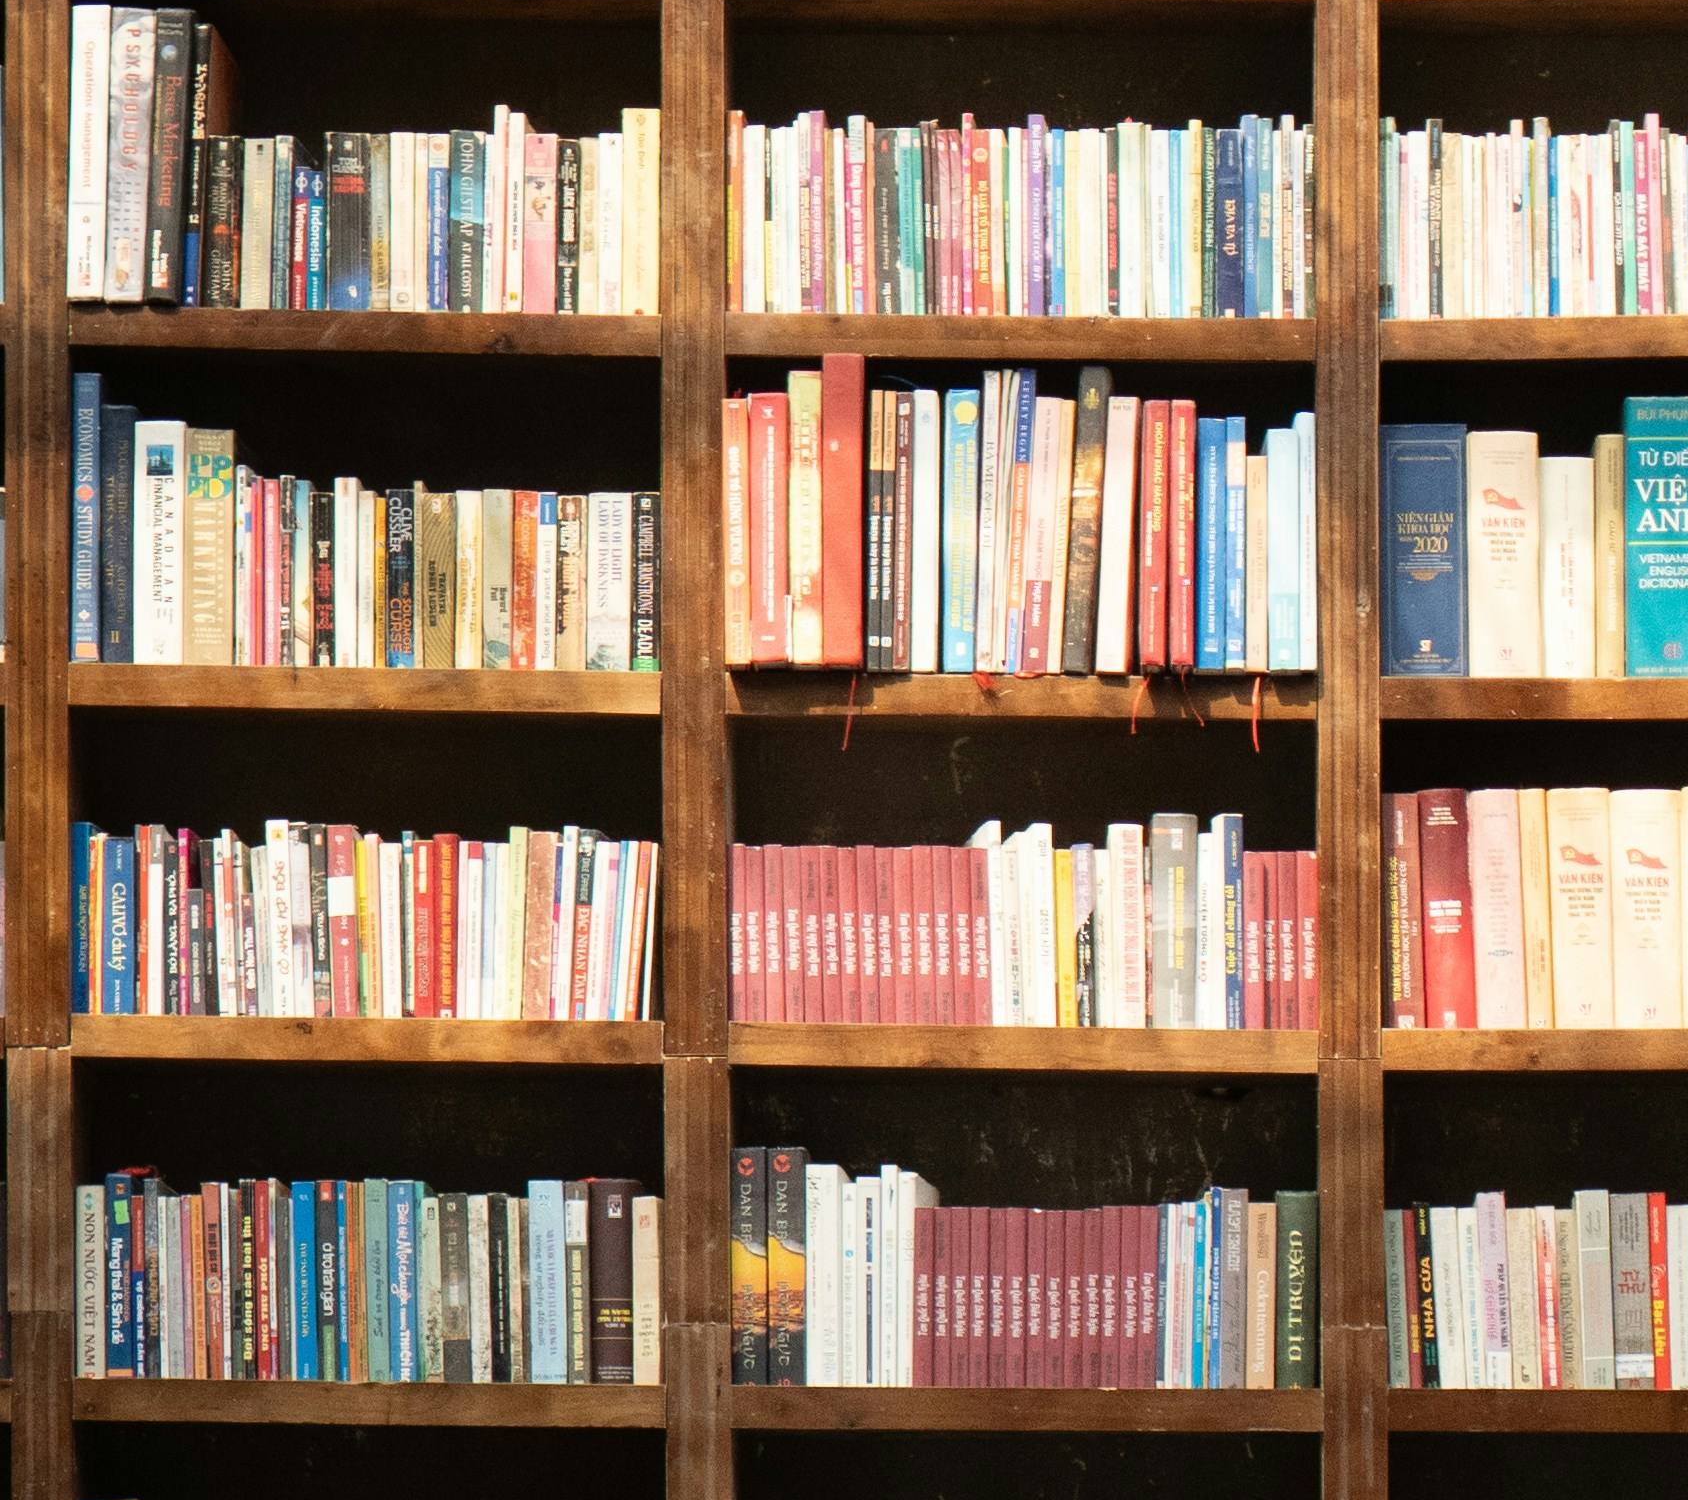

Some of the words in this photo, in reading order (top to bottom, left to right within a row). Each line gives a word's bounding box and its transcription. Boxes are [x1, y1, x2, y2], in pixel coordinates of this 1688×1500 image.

[83, 41, 96, 108] Operations
[122, 28, 142, 172] PSYCHOLOGY
[164, 75, 182, 117] Basic
[80, 112, 93, 187] Management
[158, 123, 179, 207] Marketing
[459, 137, 475, 175] JOHN
[459, 177, 475, 236] GILSTRAP
[563, 185, 575, 207] JACK
[294, 202, 306, 262] Vietnamese
[309, 204, 323, 271] Indonesian
[563, 209, 575, 242] HIGGINS
[461, 242, 472, 253] AT
[461, 255, 472, 270] ALL
[210, 249, 221, 300] GRISHAM
[221, 259, 231, 291] JOHN
[461, 271, 472, 297] COSTS
[1020, 380, 1031, 419] LESLEY
[78, 408, 94, 482] ECONOMICS
[1018, 424, 1029, 462] REGAN
[1638, 448, 1658, 467] TỪ
[152, 477, 164, 528] FINANCIAL
[598, 500, 609, 529] LADY
[612, 500, 623, 529] LADY
[76, 506, 91, 546] STUDY
[163, 477, 174, 603] CANADIAN
[389, 497, 402, 553] CUSSLER
[401, 507, 413, 542] CLIVE
[598, 532, 609, 545] OF
[612, 532, 623, 546] OF
[638, 514, 654, 557] CAMPBELL
[192, 501, 217, 624] MARKETING
[1412, 537, 1448, 553] 2020
[76, 550, 91, 590] GUIDE
[152, 532, 163, 603] MANAGEMENT
[597, 547, 609, 608] DARKNESS
[490, 586, 499, 602] Fast
[499, 586, 508, 613] Howard
[638, 561, 654, 614] ARMSTRONG
[389, 597, 402, 652] CURSE
[401, 597, 412, 653] SOLOMON
[576, 930, 591, 962] NHÂN
[575, 966, 589, 1000] TÂM
[740, 1184, 753, 1217] DAN
[775, 1180, 788, 1213] DAN
[84, 1212, 96, 1239] NON
[84, 1248, 98, 1287] NƯỚC
[110, 1237, 123, 1270] Mang
[111, 1270, 123, 1291] thai
[1420, 1256, 1434, 1293] CỬA
[83, 1291, 98, 1330] VIỆT
[111, 1293, 123, 1301] &
[111, 1302, 123, 1325] Sinh
[1652, 1299, 1665, 1329] Bạc
[1423, 1297, 1435, 1339] NHÀ
[84, 1337, 96, 1367] NAM
[260, 1325, 269, 1351] UNG
[1653, 1331, 1667, 1357] Liêu
